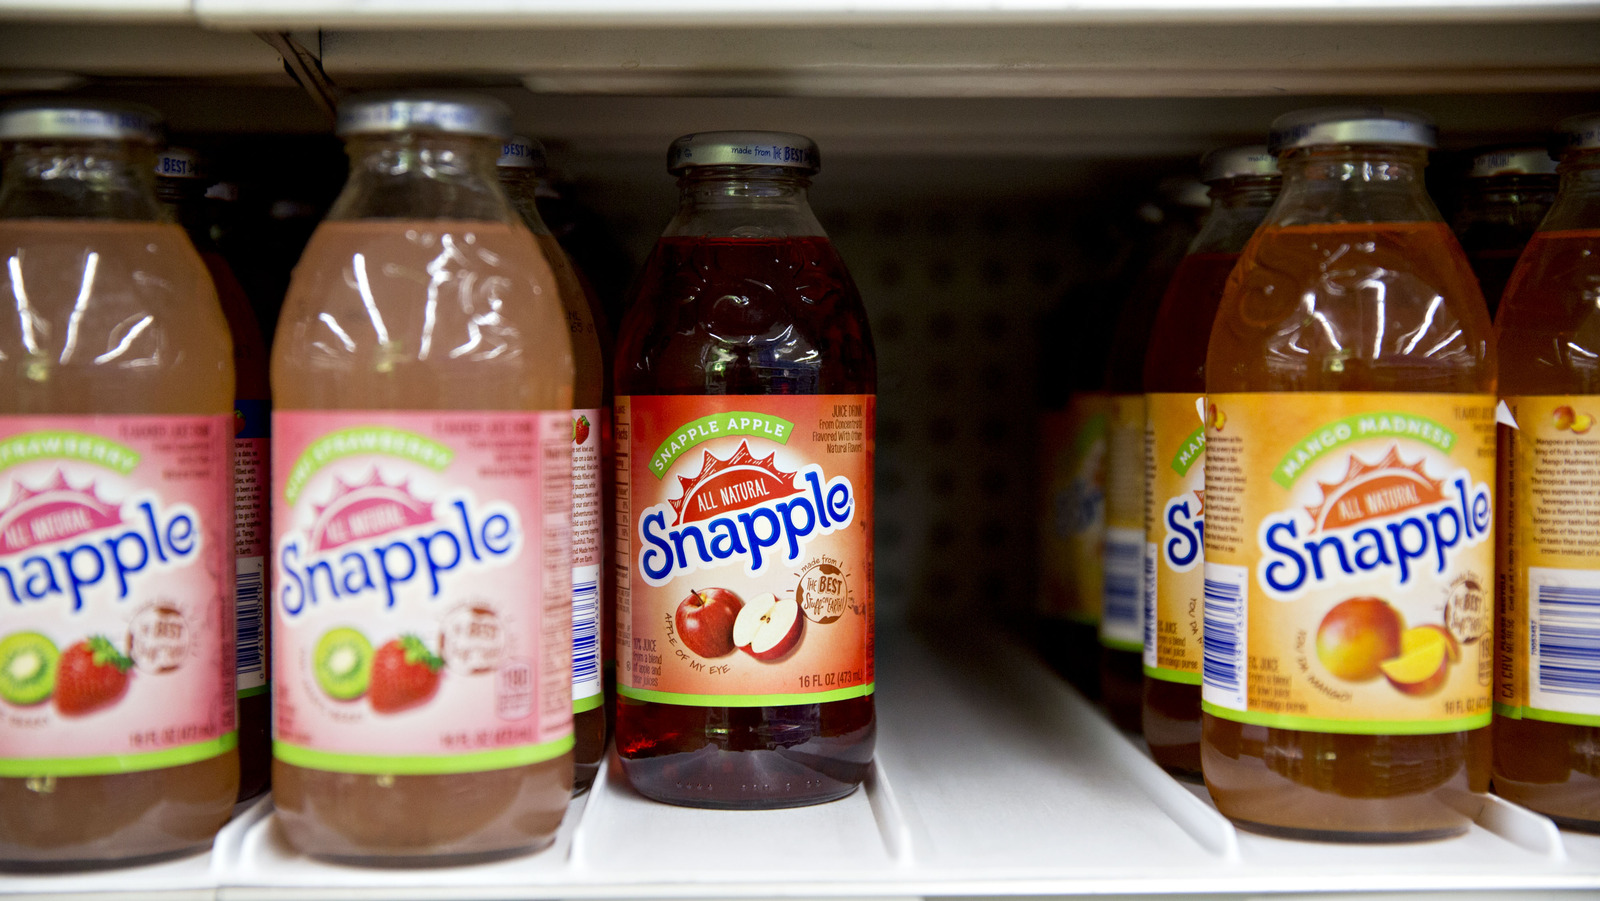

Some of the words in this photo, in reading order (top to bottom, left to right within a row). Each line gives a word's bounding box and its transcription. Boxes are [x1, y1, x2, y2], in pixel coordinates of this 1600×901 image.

[504, 144, 524, 157] BEST
[731, 146, 752, 155] made
[754, 146, 770, 157] from
[772, 146, 782, 160] THE
[784, 147, 804, 163] BEST
[163, 157, 187, 173] BEST
[832, 404, 847, 418] JUICE
[819, 419, 834, 430] From
[655, 420, 720, 471] SNAPPLE
[727, 417, 785, 437] APPLE
[812, 431, 837, 442] Flavored
[838, 431, 850, 441] With
[0, 436, 134, 469] TRAWBERRY
[827, 443, 847, 453] Natural
[1179, 432, 1206, 467] MAN
[1283, 423, 1352, 478] MANGO
[1358, 416, 1451, 449] MADNESS
[697, 493, 718, 513] ALL
[720, 477, 770, 506] NATURAL
[1337, 499, 1364, 521] ALL
[1365, 484, 1421, 514] NATURAL
[1586, 508, 1600, 516] brea
[642, 470, 852, 580] Snapple
[1265, 479, 1491, 592] Snapple
[0, 501, 195, 612] napple
[280, 500, 513, 616] Snapple
[801, 557, 820, 573] made
[821, 554, 837, 566] from
[806, 577, 817, 592] THE
[819, 576, 843, 596] BEST
[1189, 620, 1200, 635] DA
[642, 639, 656, 652] JUICE
[664, 612, 676, 647] APPLE
[675, 649, 688, 661] OF
[689, 659, 705, 673] MY
[709, 663, 731, 675] EYE
[649, 654, 662, 665] blend
[1501, 654, 1514, 679] CRV
[639, 663, 651, 675] apple
[651, 666, 661, 676] and
[799, 675, 810, 688] 16
[812, 674, 823, 687] FL
[825, 673, 835, 686] OZ
[837, 670, 852, 687] (473
[1501, 684, 1514, 699] CA
